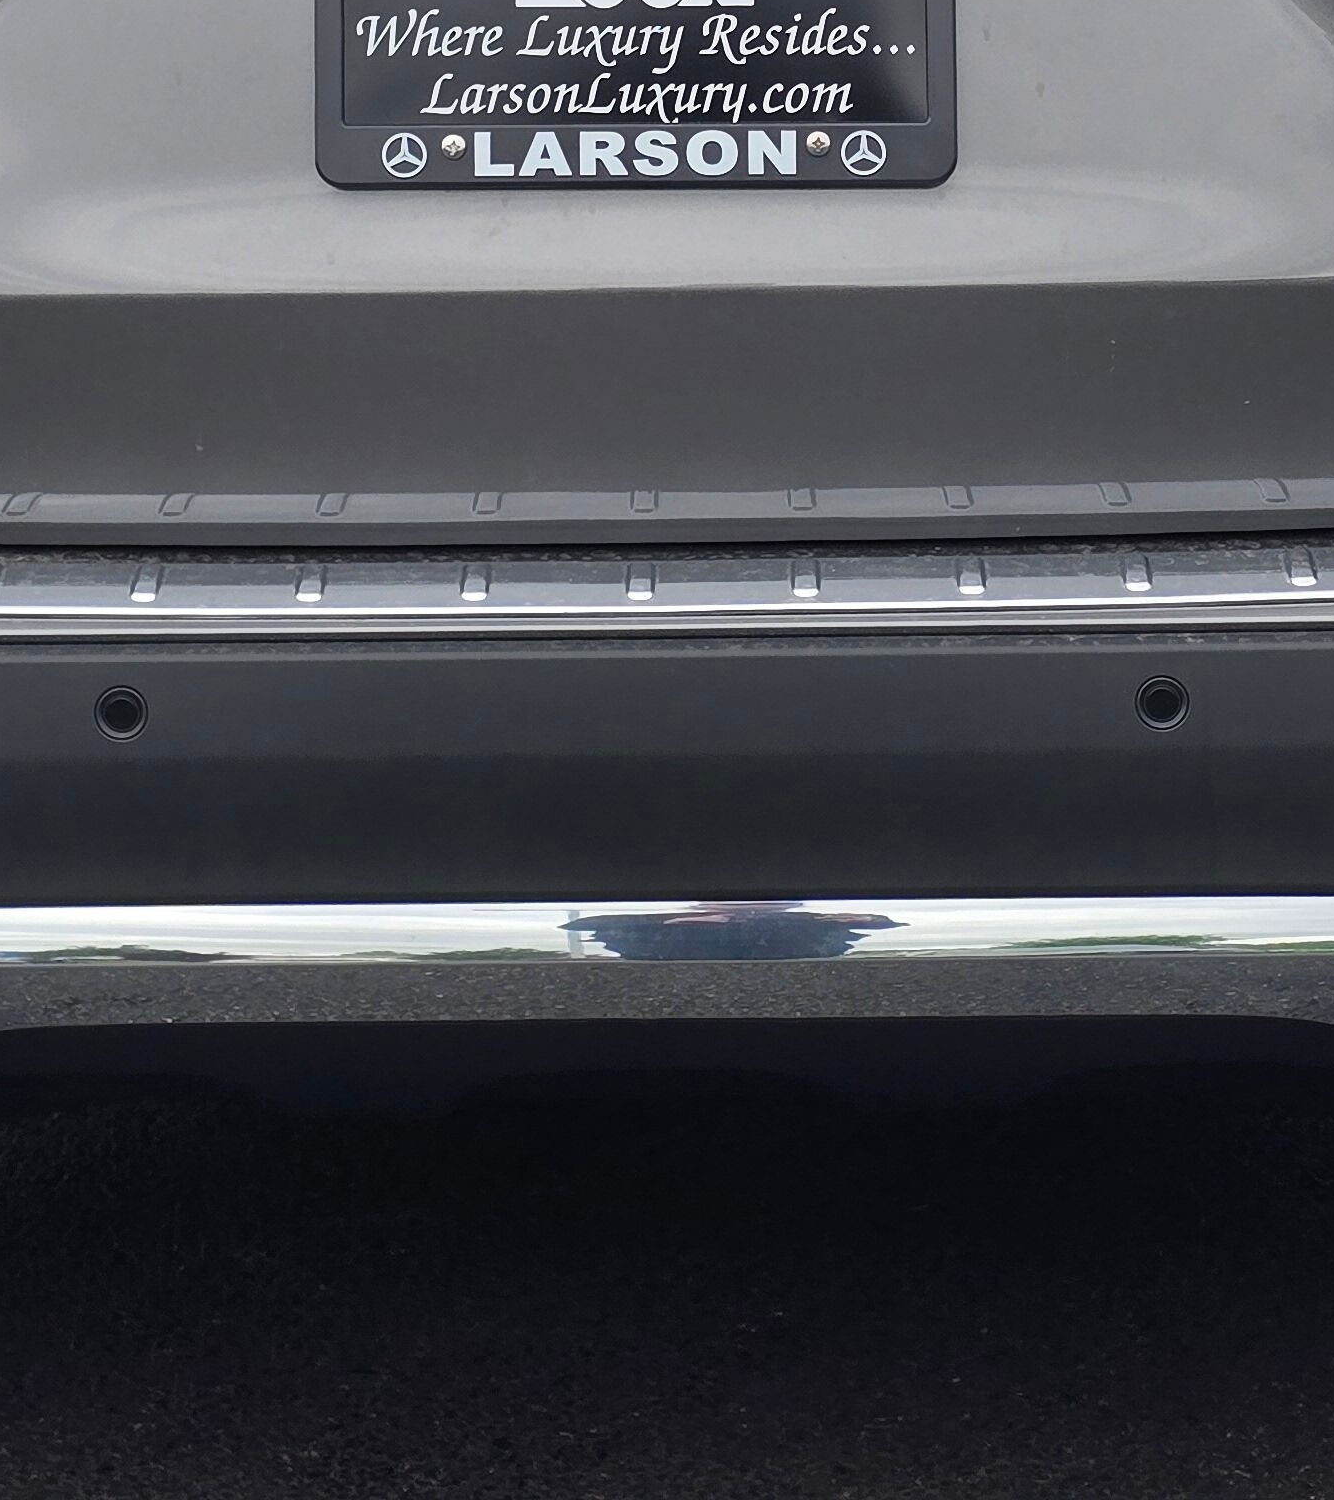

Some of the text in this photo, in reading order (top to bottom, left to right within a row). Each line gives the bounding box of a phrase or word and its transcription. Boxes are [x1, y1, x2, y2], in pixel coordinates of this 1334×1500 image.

[356, 7, 916, 74] Where Luxury Resides...
[420, 72, 854, 124] LarsonLuxury.com
[473, 129, 798, 177] LARSON
